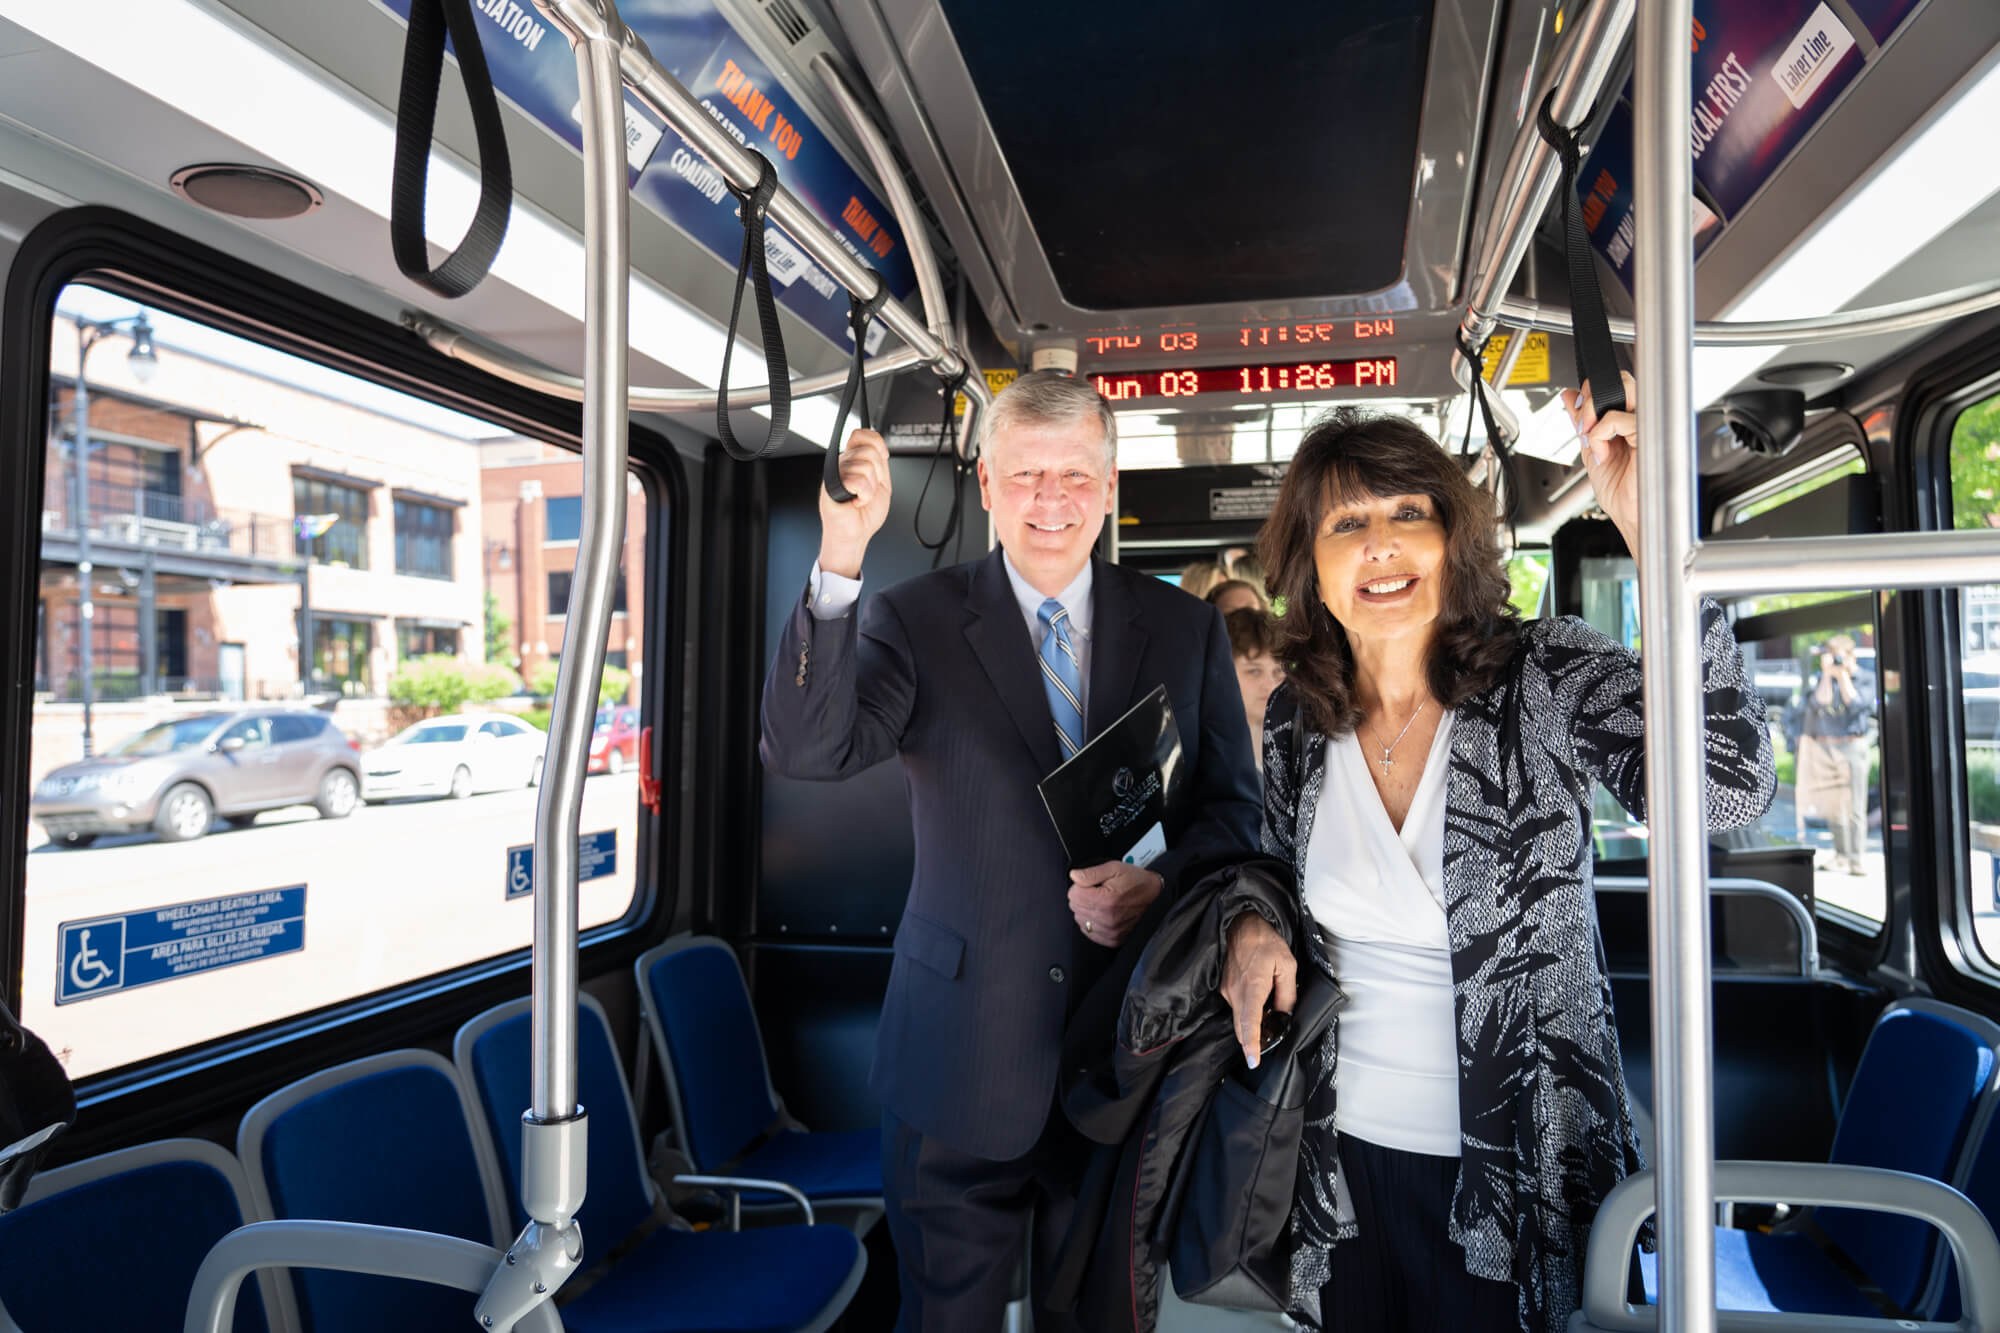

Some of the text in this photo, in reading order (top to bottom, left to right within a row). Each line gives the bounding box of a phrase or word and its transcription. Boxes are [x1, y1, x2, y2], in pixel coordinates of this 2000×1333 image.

[1705, 51, 1752, 116] FIRST
[1780, 30, 1832, 93] Laker Line
[715, 58, 775, 132] THANK
[769, 112, 803, 160] YOU
[1691, 100, 1723, 160] OCAL
[670, 148, 729, 205] COALITION
[1160, 370, 1198, 397] 03
[1239, 362, 1336, 393] 11:26
[1354, 359, 1396, 388] PM
[156, 902, 219, 923] WHEELCHAIR
[220, 894, 258, 913] SEATING
[179, 937, 206, 954] PARA
